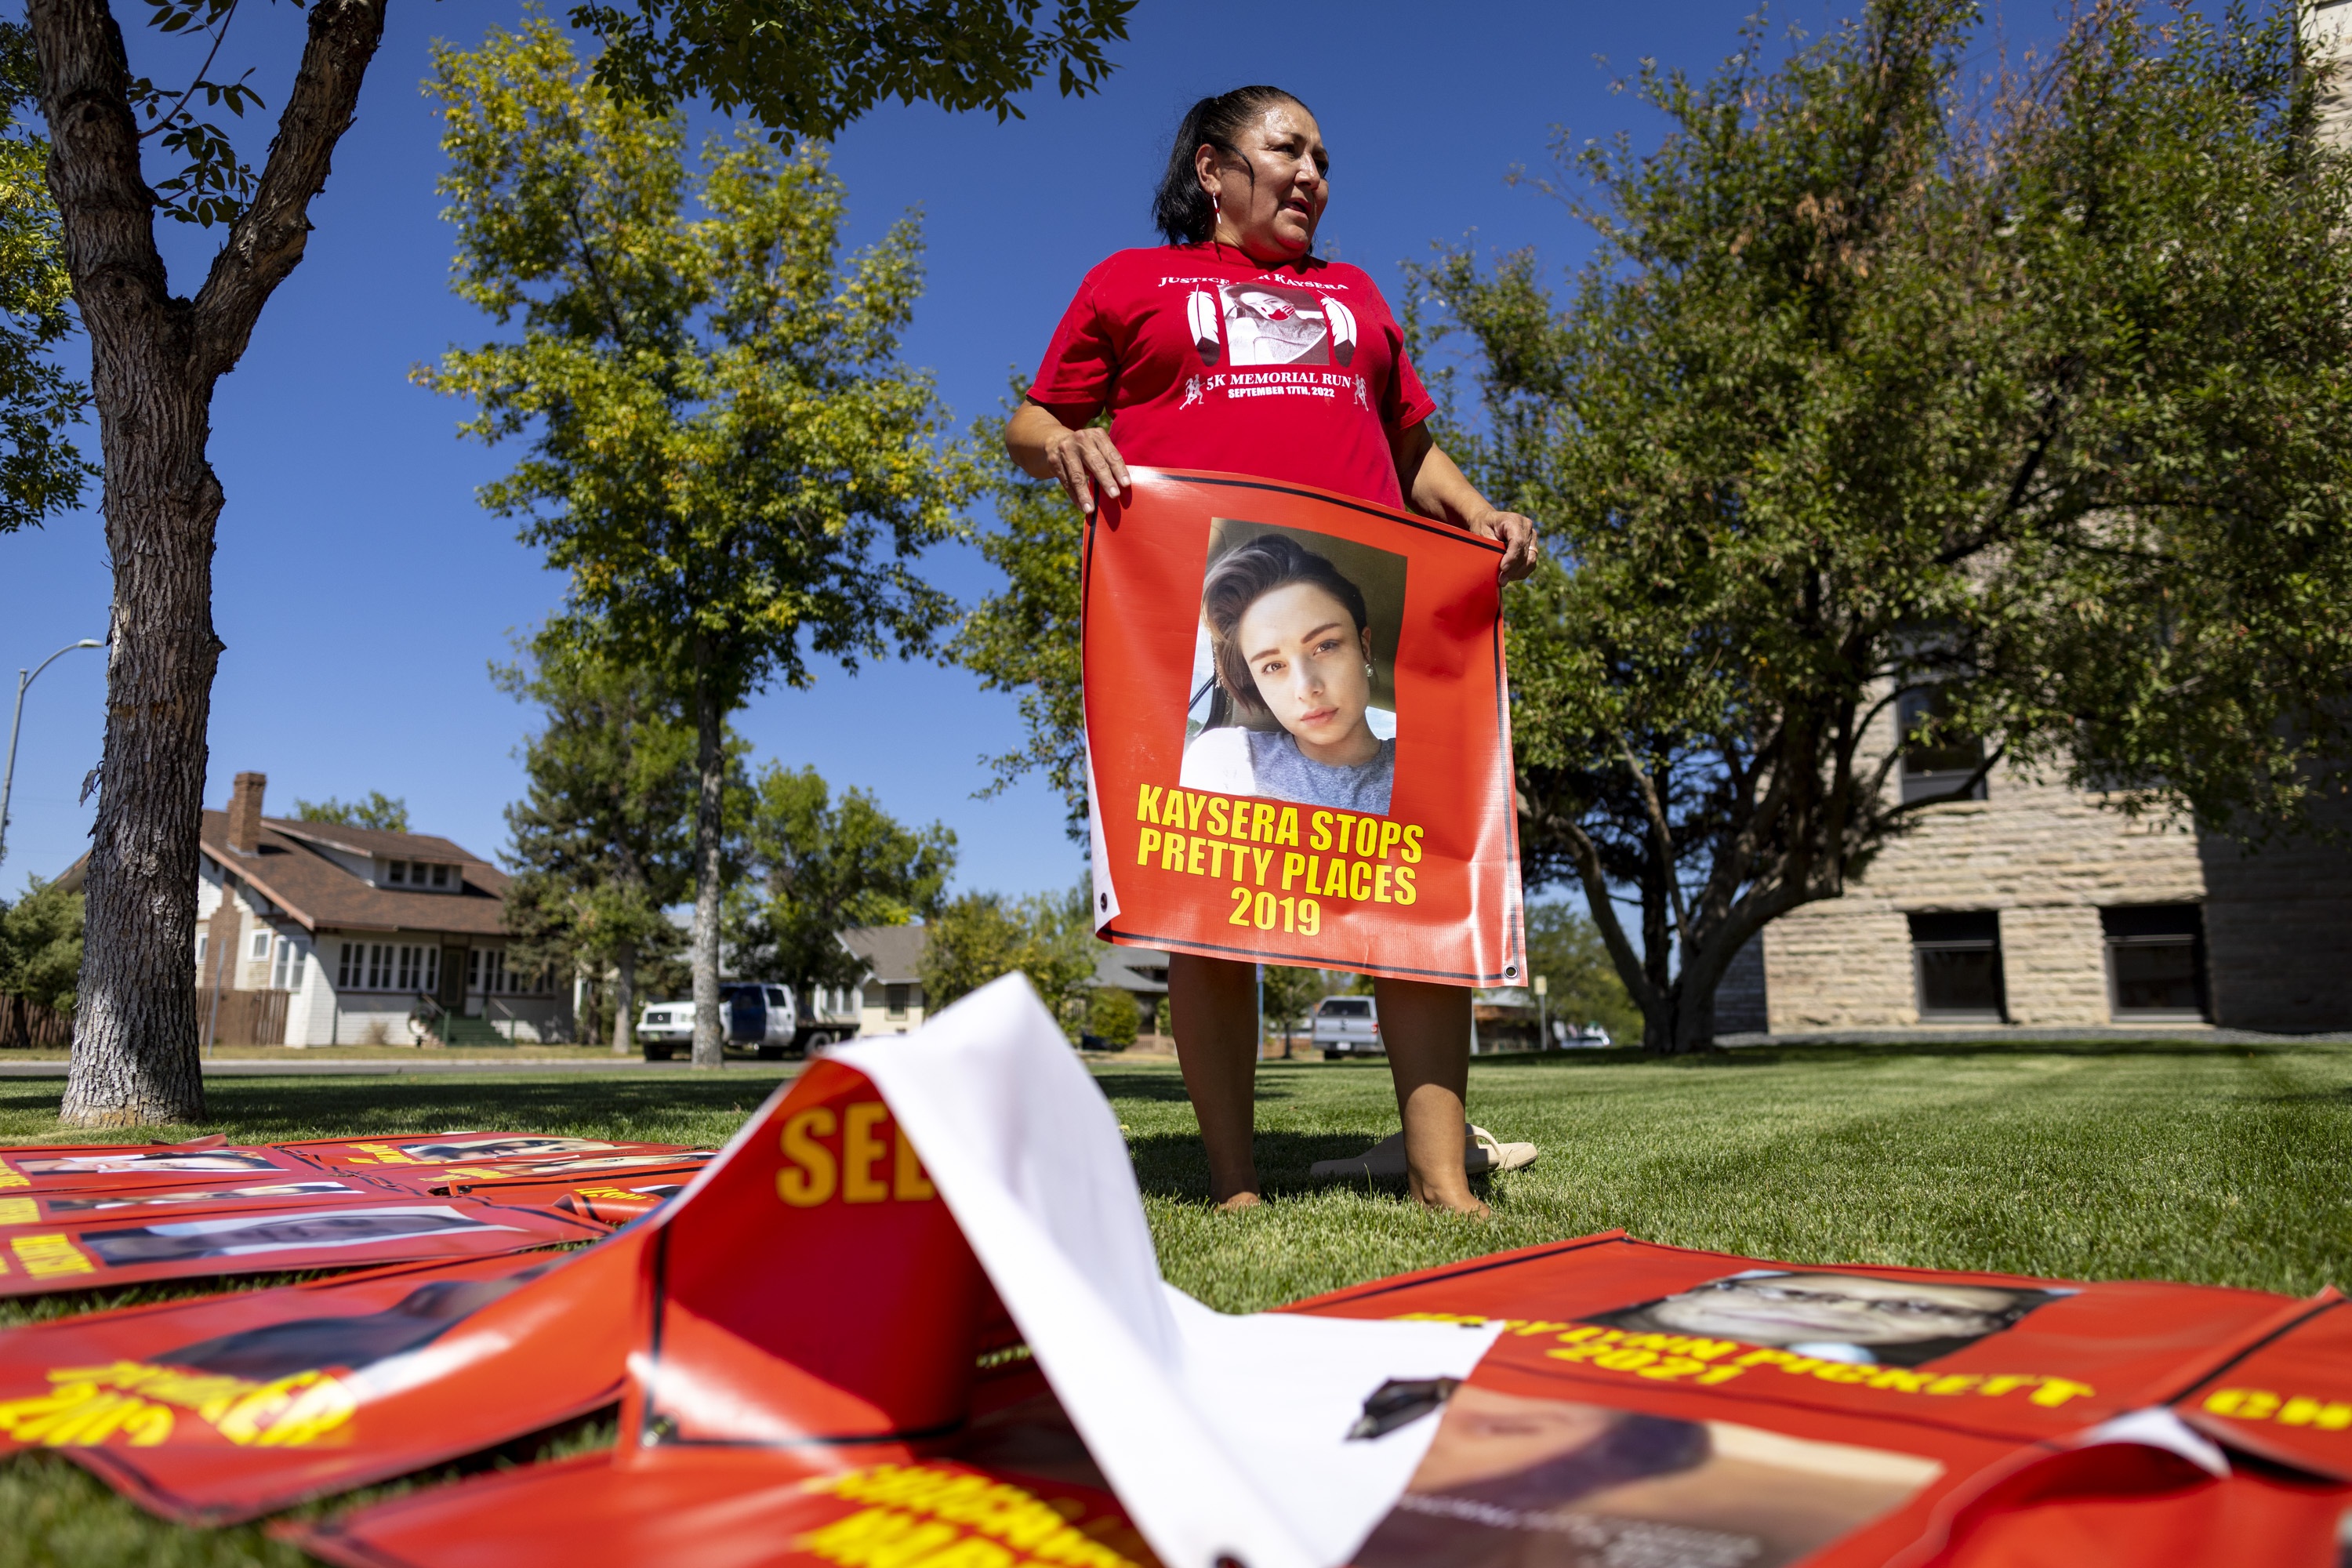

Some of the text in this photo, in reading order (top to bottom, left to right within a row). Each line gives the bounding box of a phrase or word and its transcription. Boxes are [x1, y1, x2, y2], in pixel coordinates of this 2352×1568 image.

[1158, 277, 1230, 287] JUSTICE
[1274, 274, 1349, 289] KAYSERA
[1206, 372, 1352, 390] 5K MEMORIAL RUN
[1228, 386, 1335, 398] SEPTEMBER 17TH, 2022
[1136, 783, 1425, 864] KAYSERA STOPS
[1137, 827, 1417, 906] PRETTY PLACES
[1228, 887, 1321, 936] 2019
